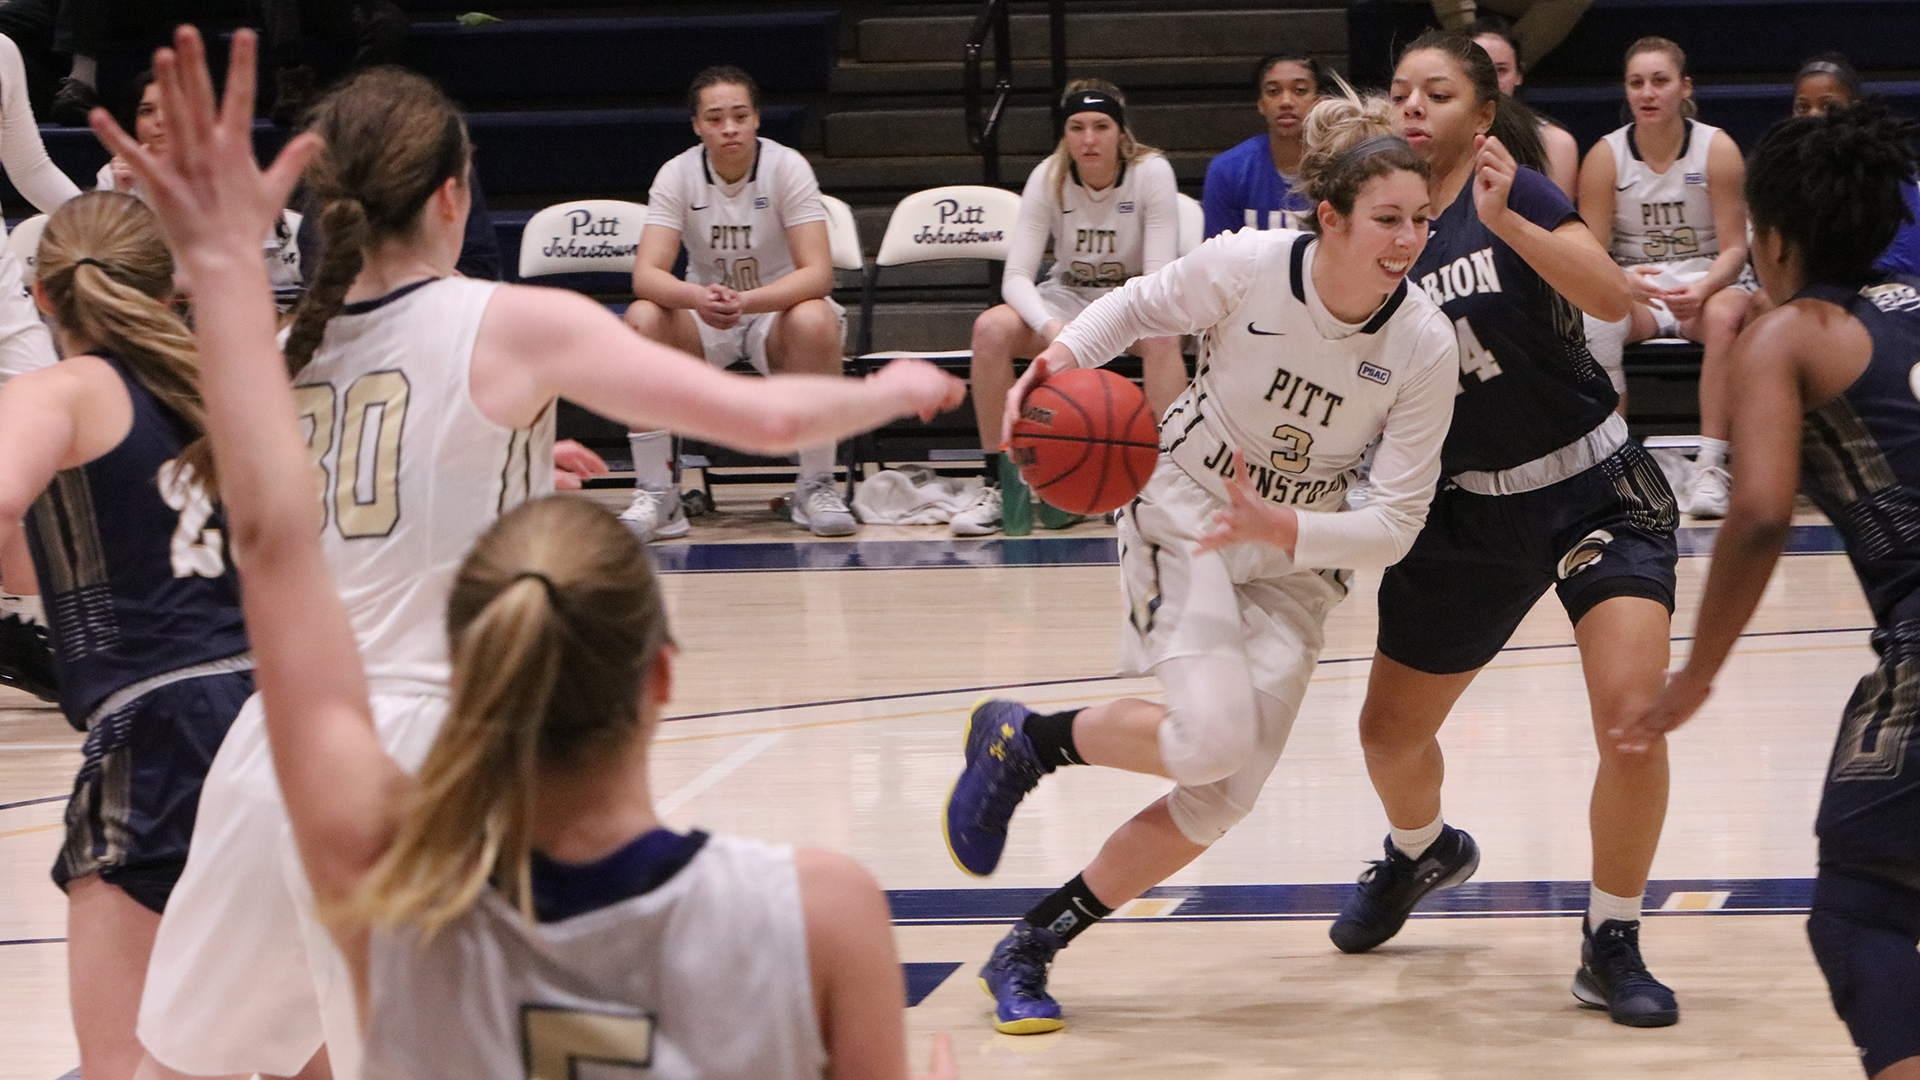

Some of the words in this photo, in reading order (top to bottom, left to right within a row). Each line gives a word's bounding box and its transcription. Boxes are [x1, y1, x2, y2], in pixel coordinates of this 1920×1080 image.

[563, 209, 621, 236] Pitt
[932, 199, 986, 224] Pitt
[1641, 201, 1686, 225] PITT
[710, 225, 753, 250] PITT
[913, 225, 1004, 244] Johnstown
[1075, 229, 1117, 254] PITT
[1414, 246, 1502, 307] RION
[1454, 316, 1504, 396] 4
[1362, 365, 1387, 381] PSAC
[1264, 367, 1343, 427] PITT
[1270, 423, 1314, 474] 3
